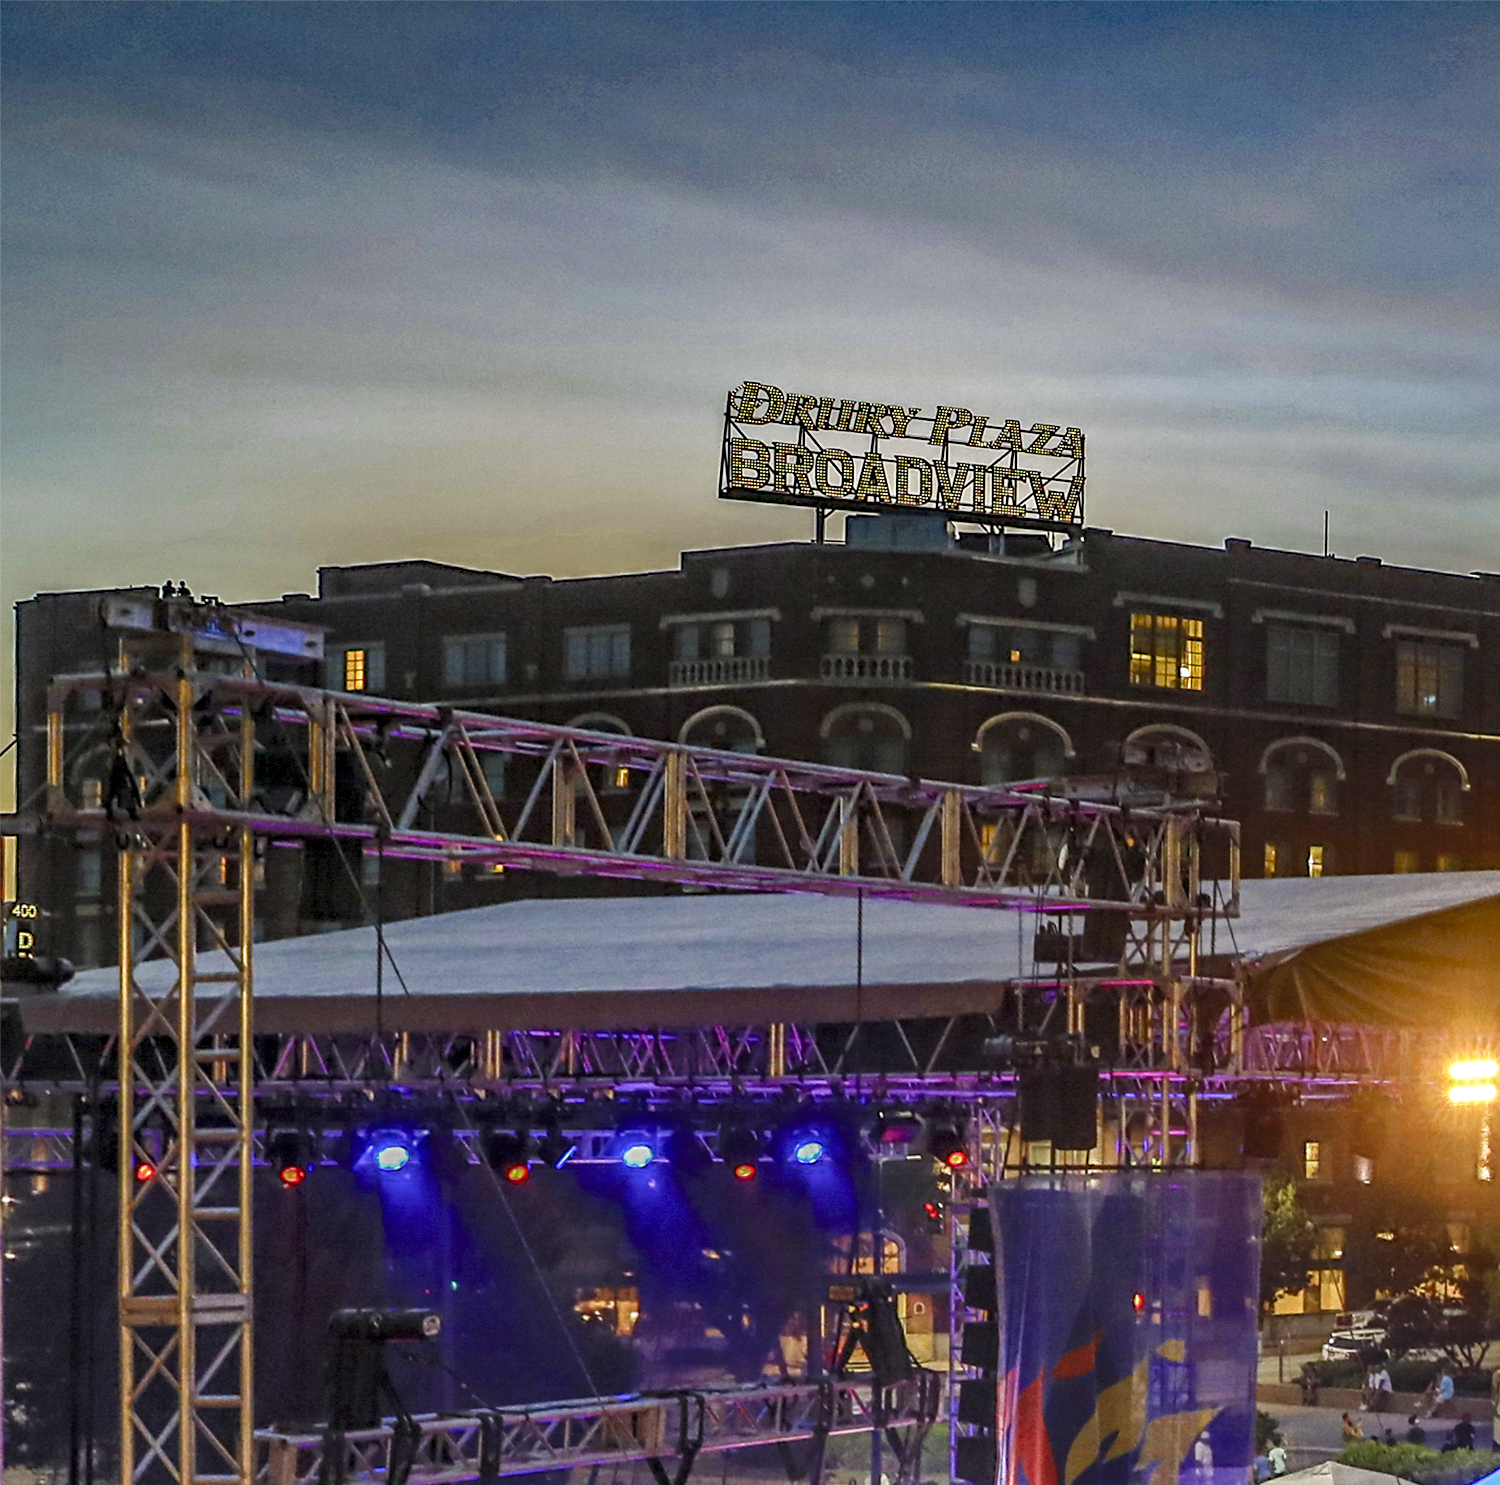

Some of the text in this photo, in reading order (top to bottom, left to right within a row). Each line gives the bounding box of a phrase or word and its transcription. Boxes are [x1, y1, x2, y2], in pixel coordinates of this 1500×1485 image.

[730, 381, 1085, 459] DRURY PLAZA
[730, 437, 1086, 523] BROADVIEW
[12, 904, 38, 918] 400
